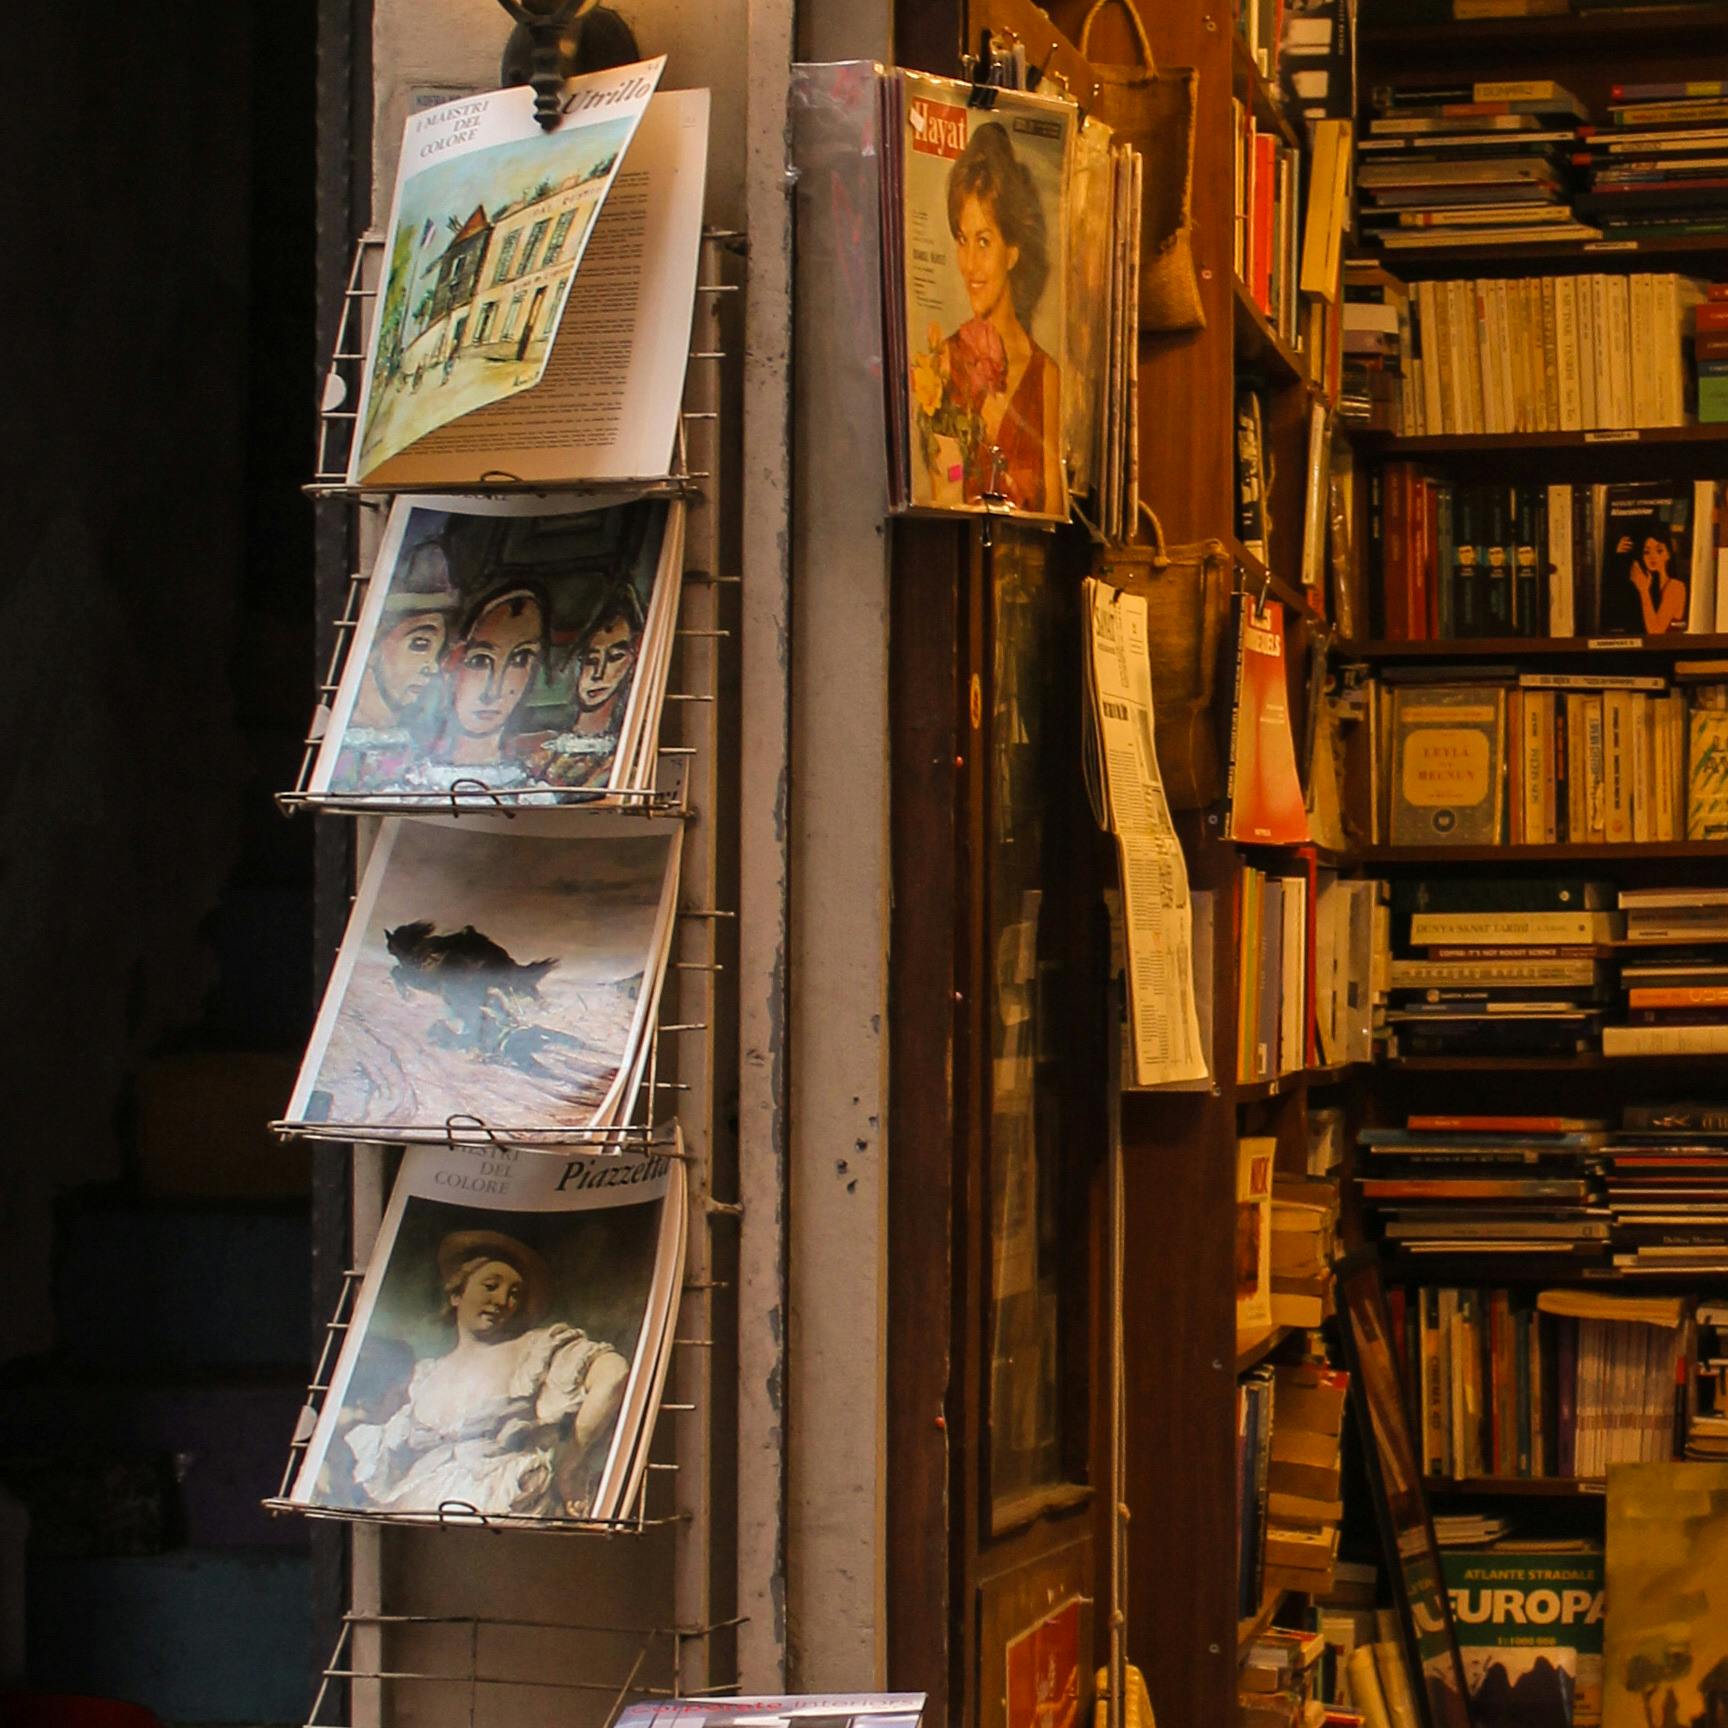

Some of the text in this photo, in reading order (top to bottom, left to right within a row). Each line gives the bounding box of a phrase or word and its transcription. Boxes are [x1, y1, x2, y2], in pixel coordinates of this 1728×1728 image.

[562, 77, 651, 116] Utrillo
[424, 100, 490, 129] MAESTRI
[453, 116, 482, 132] DEL
[914, 102, 967, 155] Hayat
[419, 128, 479, 159] COLORE
[434, 1170, 511, 1194] COLORE
[479, 1161, 513, 1179] DEL
[554, 1153, 670, 1192] Piazzetta
[1463, 1569, 1525, 1581] ATLANTE
[628, 1699, 783, 1716] Corporate
